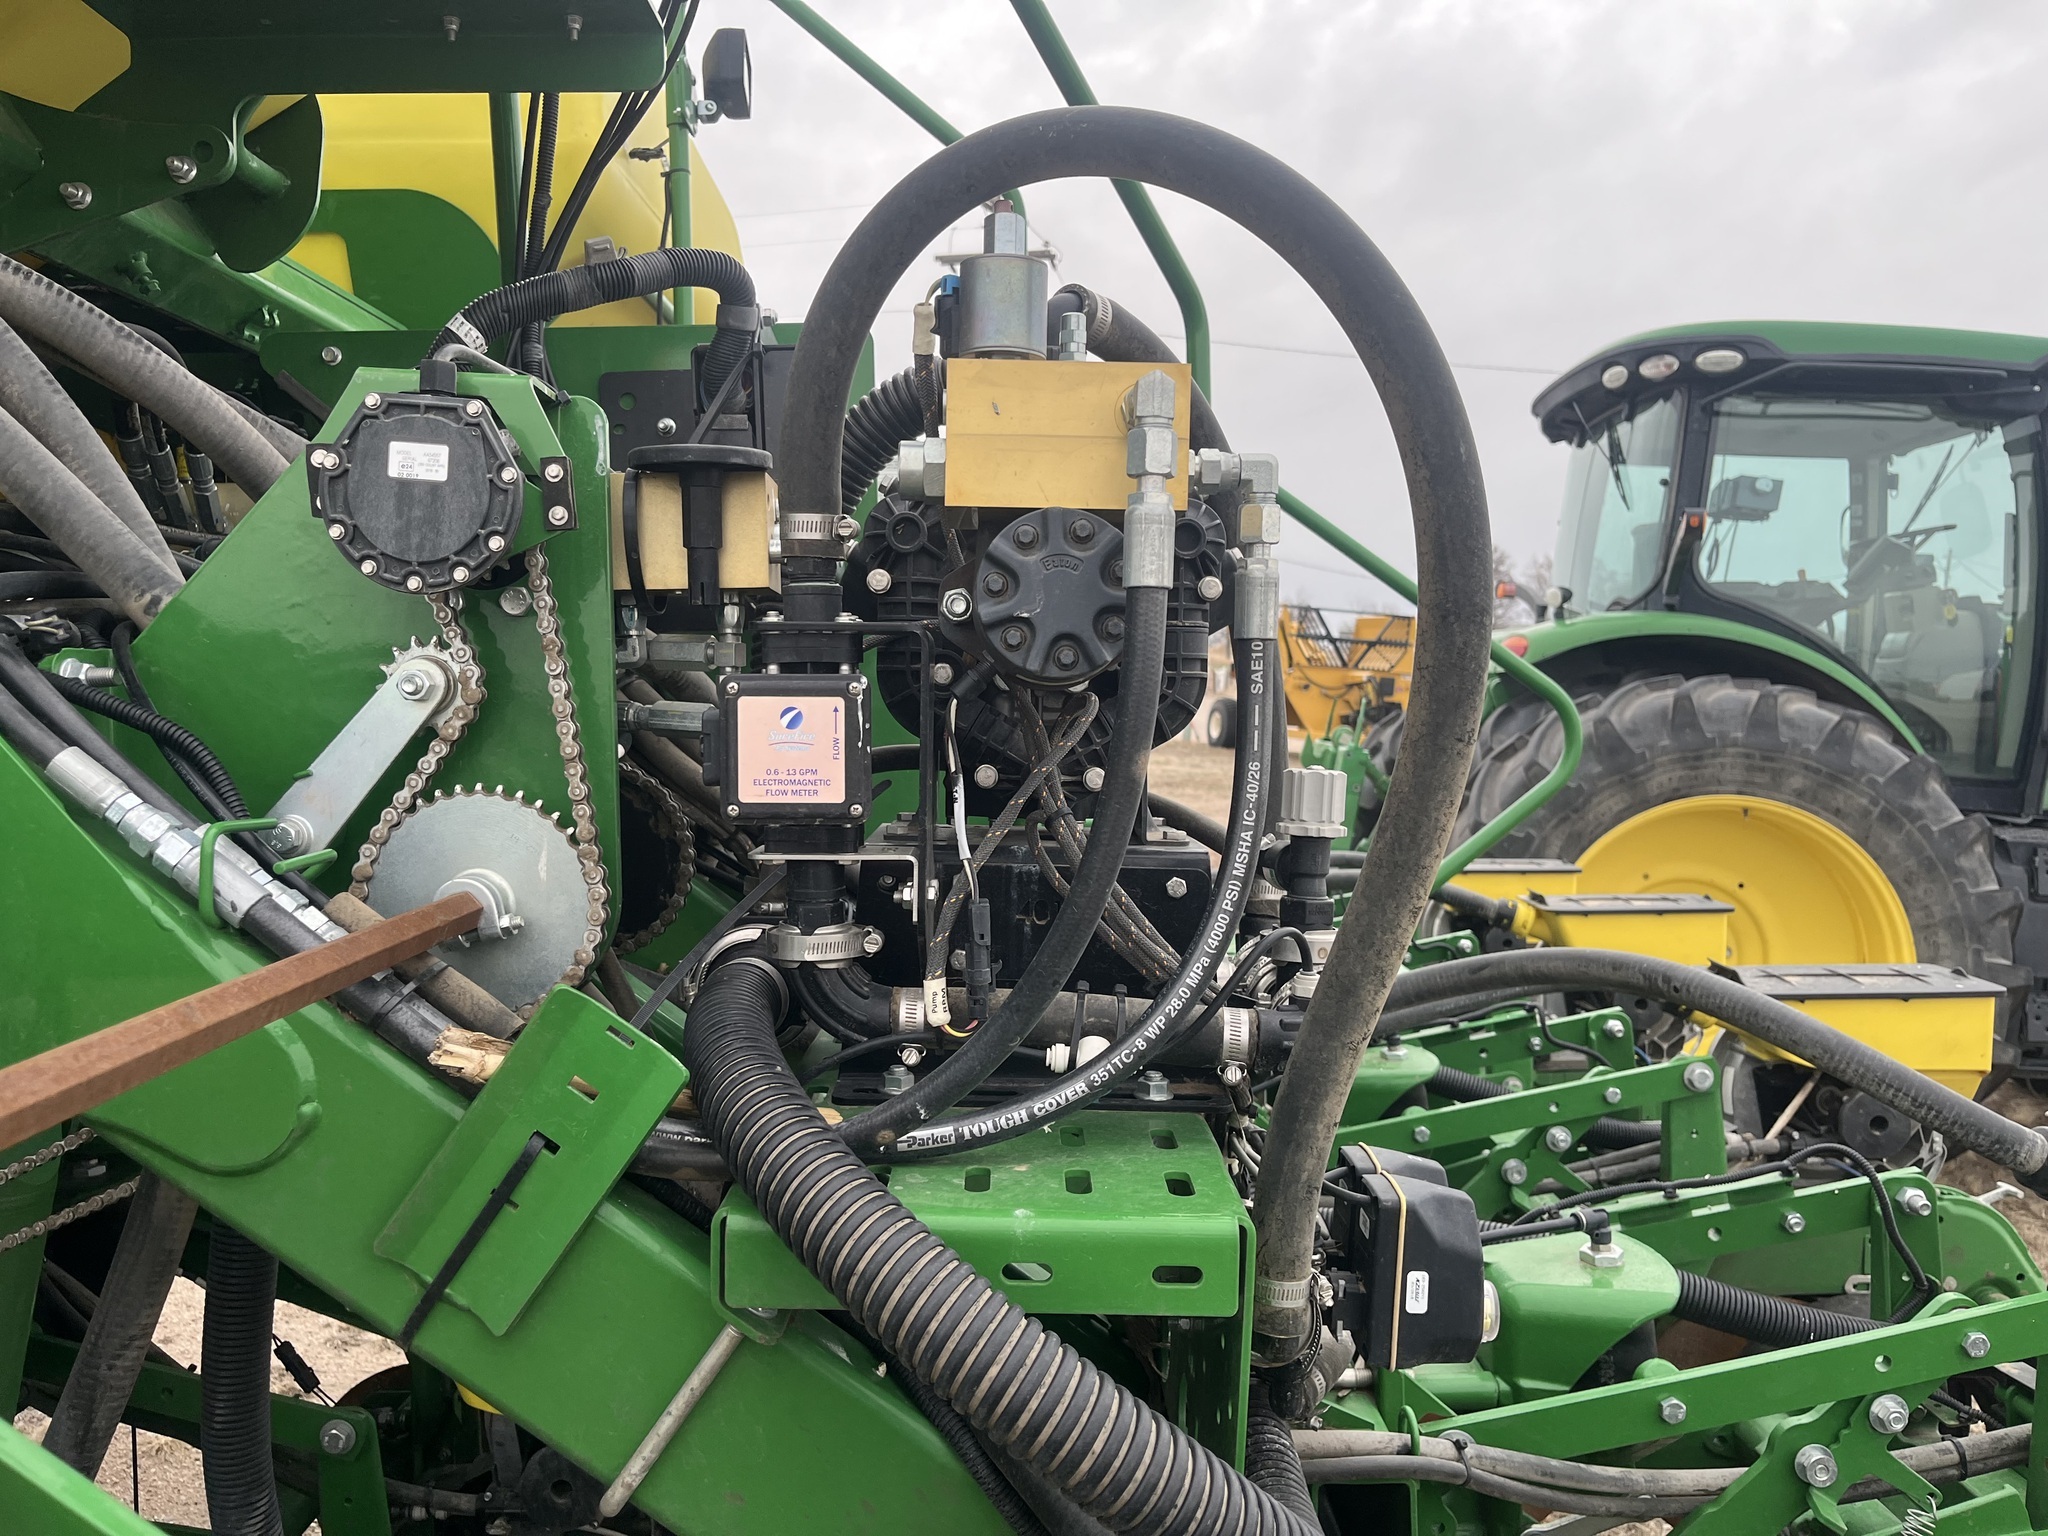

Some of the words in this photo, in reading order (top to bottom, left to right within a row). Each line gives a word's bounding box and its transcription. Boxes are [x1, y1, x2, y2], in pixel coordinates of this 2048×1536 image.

[1042, 557, 1080, 572] Eaton
[753, 778, 831, 787] ELECTROMAGNETIC
[765, 768, 780, 776] 0.6
[786, 768, 797, 776] 13
[798, 768, 818, 776] GPM
[765, 789, 790, 797] FLOW
[790, 789, 819, 797] METER
[1242, 761, 1261, 826] IC-40/26
[1235, 830, 1254, 877] MSHA
[1221, 880, 1243, 912] PSI)
[1203, 913, 1230, 954] (4000
[1185, 955, 1211, 988] MPa
[1165, 986, 1191, 1018] 28,0
[1143, 1015, 1167, 1040] WP
[1090, 1037, 1148, 1087] 351TC-8
[1032, 1080, 1091, 1119] COVER
[903, 1129, 955, 1150] Parker
[958, 1108, 1031, 1141] TOUGH
